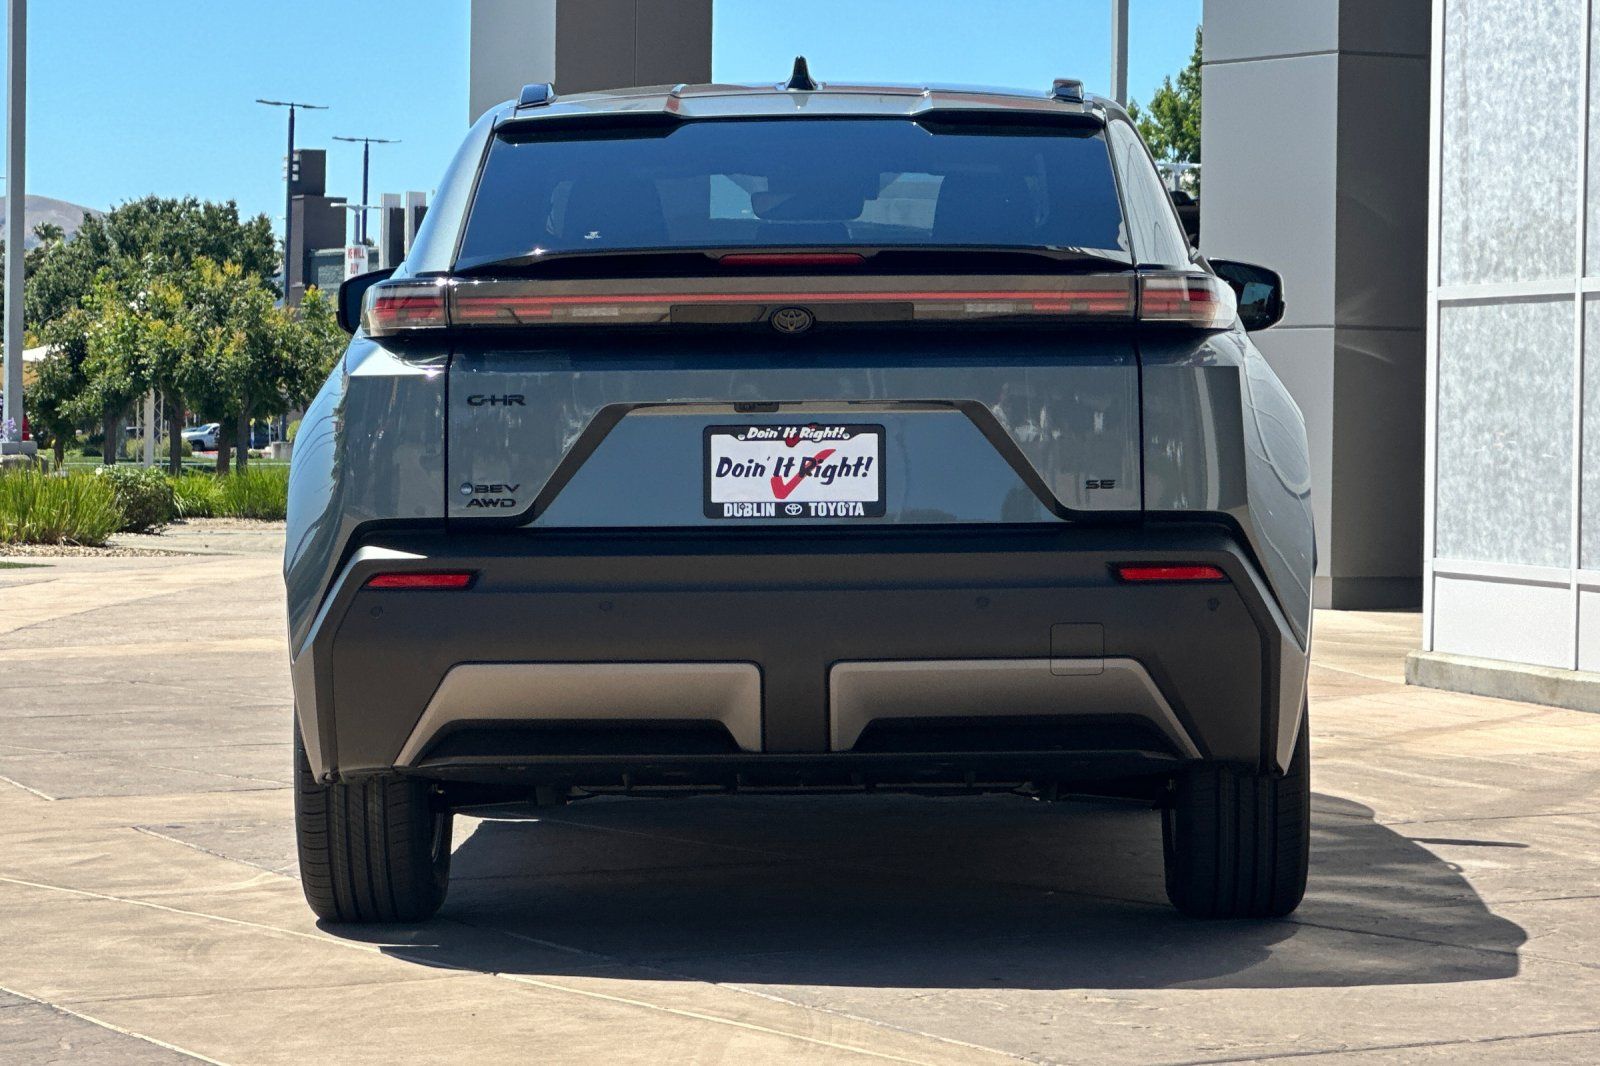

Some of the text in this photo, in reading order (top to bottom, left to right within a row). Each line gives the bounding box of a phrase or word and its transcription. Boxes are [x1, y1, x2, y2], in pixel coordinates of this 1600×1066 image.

[747, 427, 845, 441] Doin' It Right!
[716, 456, 873, 485] Doin' It Right!
[475, 484, 520, 493] BEV
[1085, 480, 1116, 489] SE
[466, 498, 516, 508] AWD
[724, 502, 864, 517] DUBLIN TOYOTA
